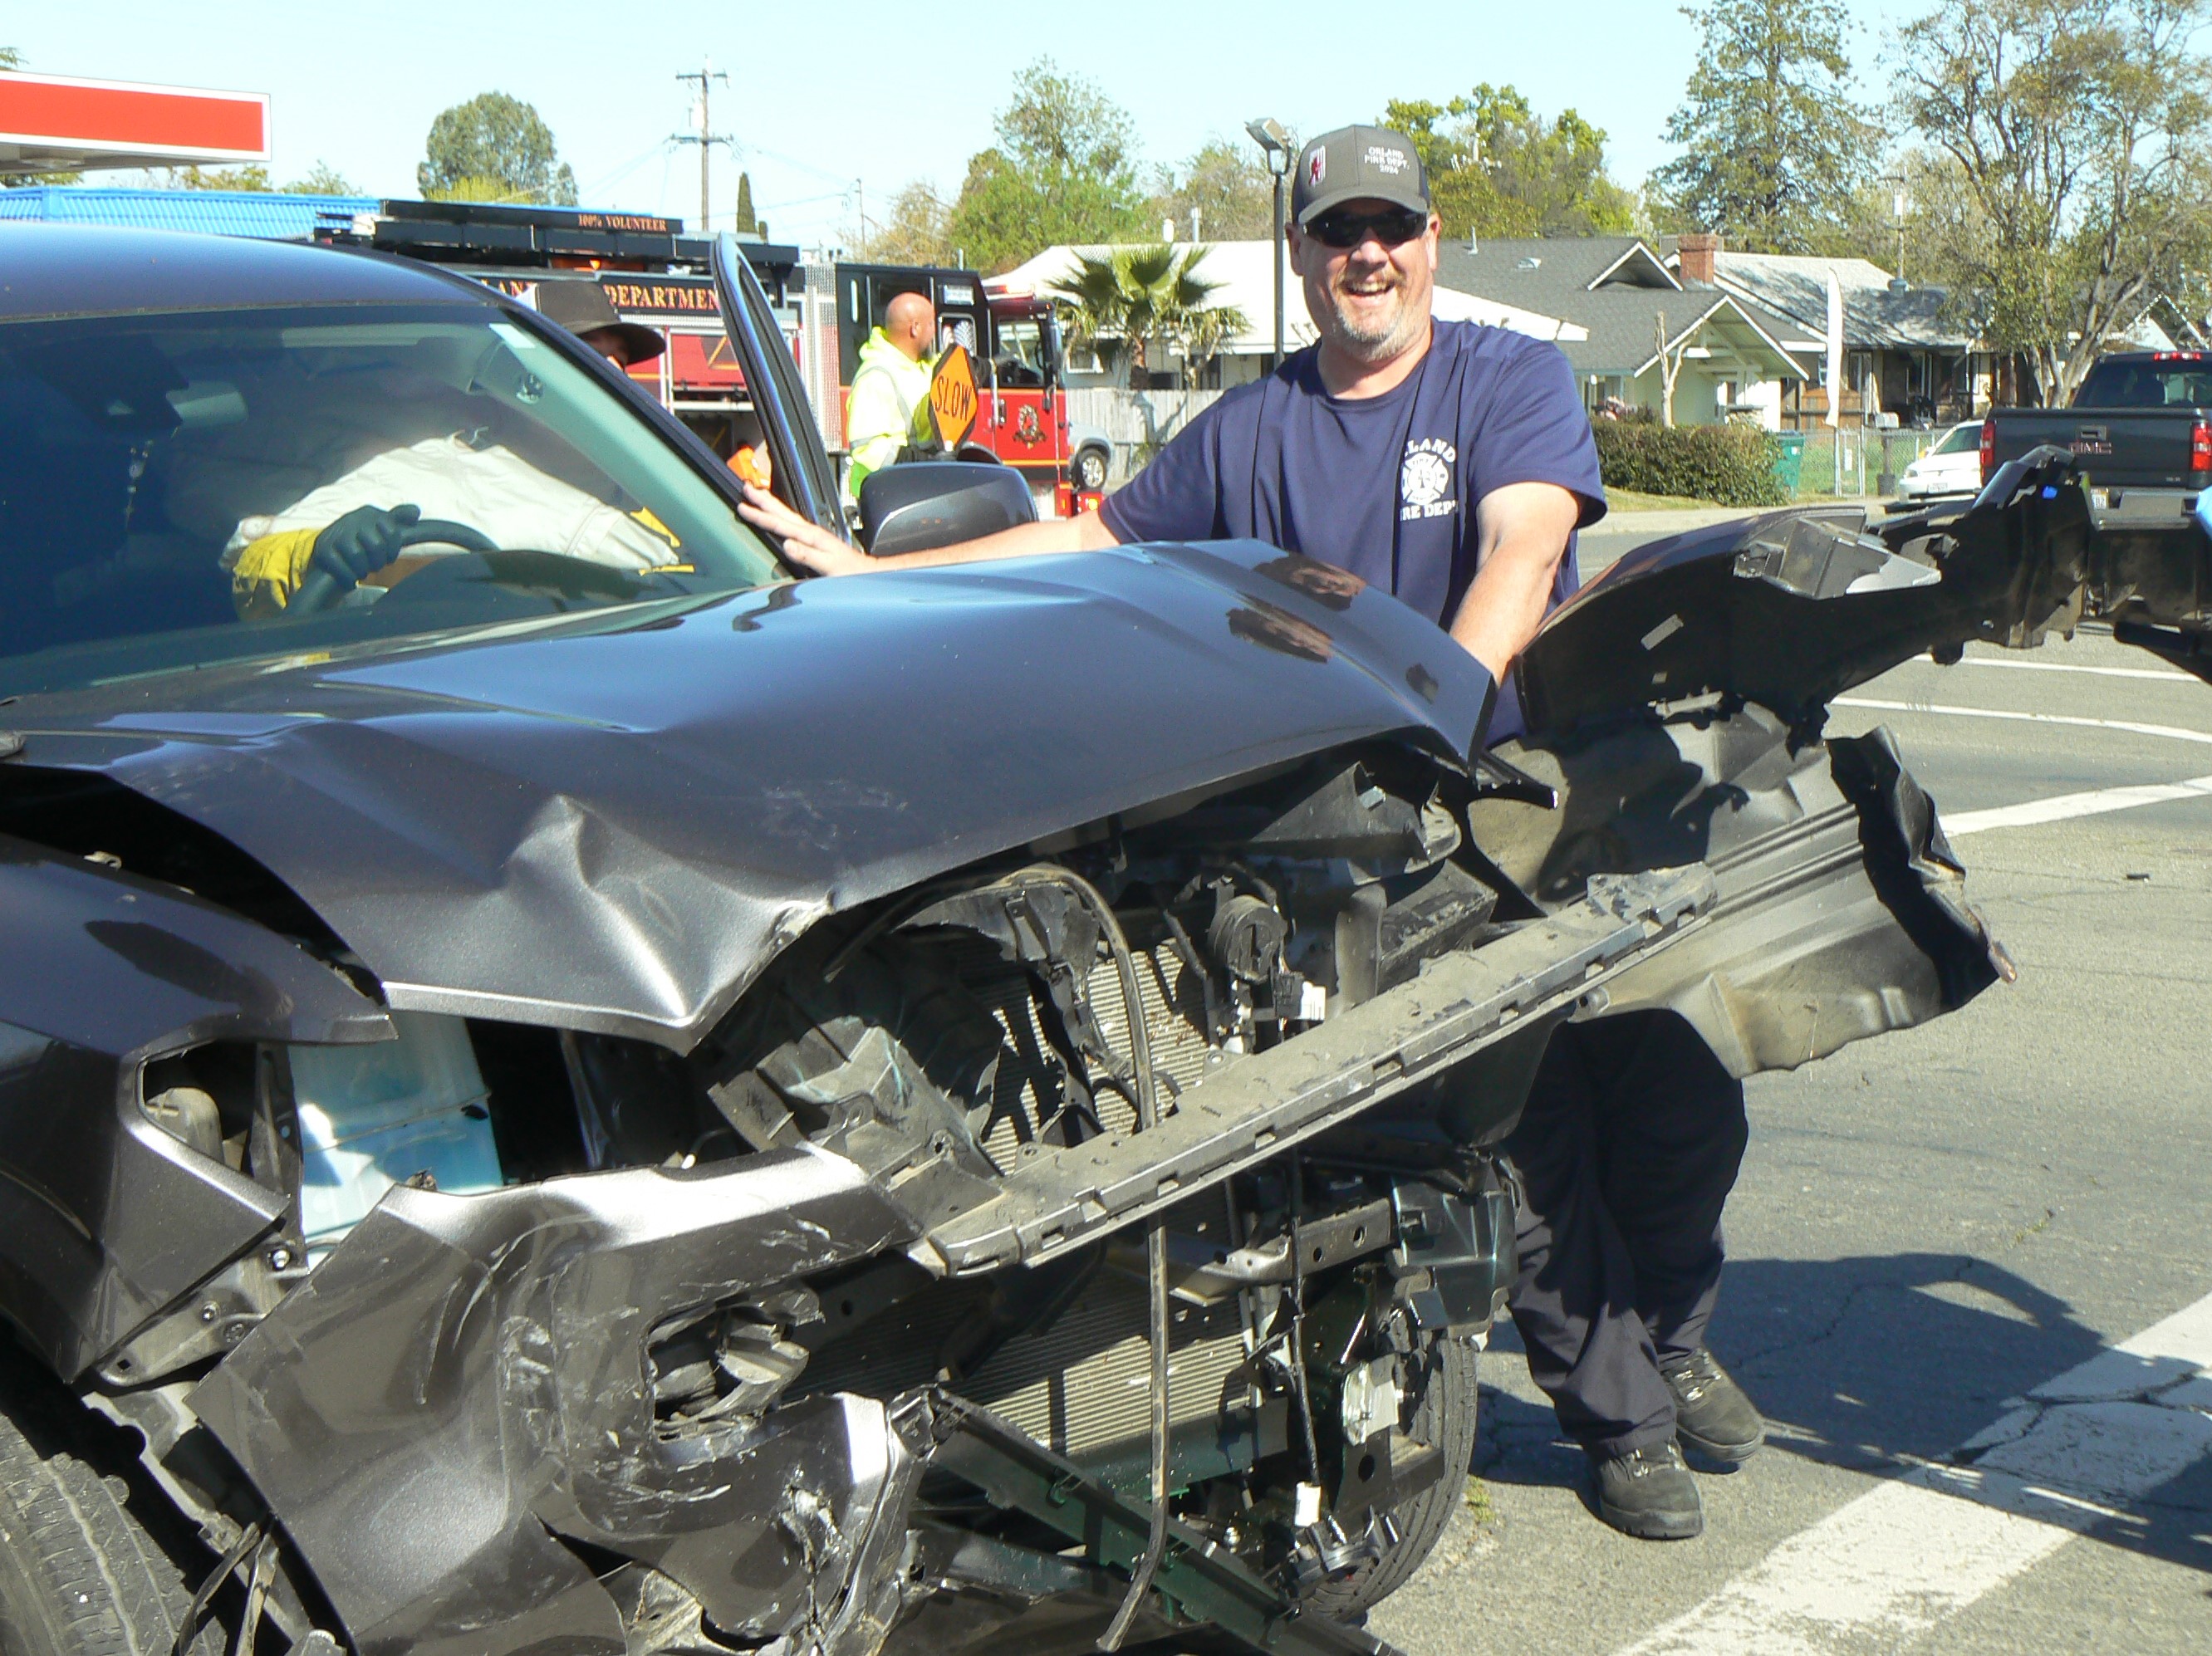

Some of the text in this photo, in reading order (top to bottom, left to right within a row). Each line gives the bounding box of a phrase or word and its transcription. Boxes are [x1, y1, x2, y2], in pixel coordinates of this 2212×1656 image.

[1368, 146, 1404, 159] ORLAND
[606, 214, 667, 232] VOLUNTEER
[934, 375, 973, 422] SLOW
[1405, 438, 1456, 463] LAND
[2068, 440, 2112, 455] GMC
